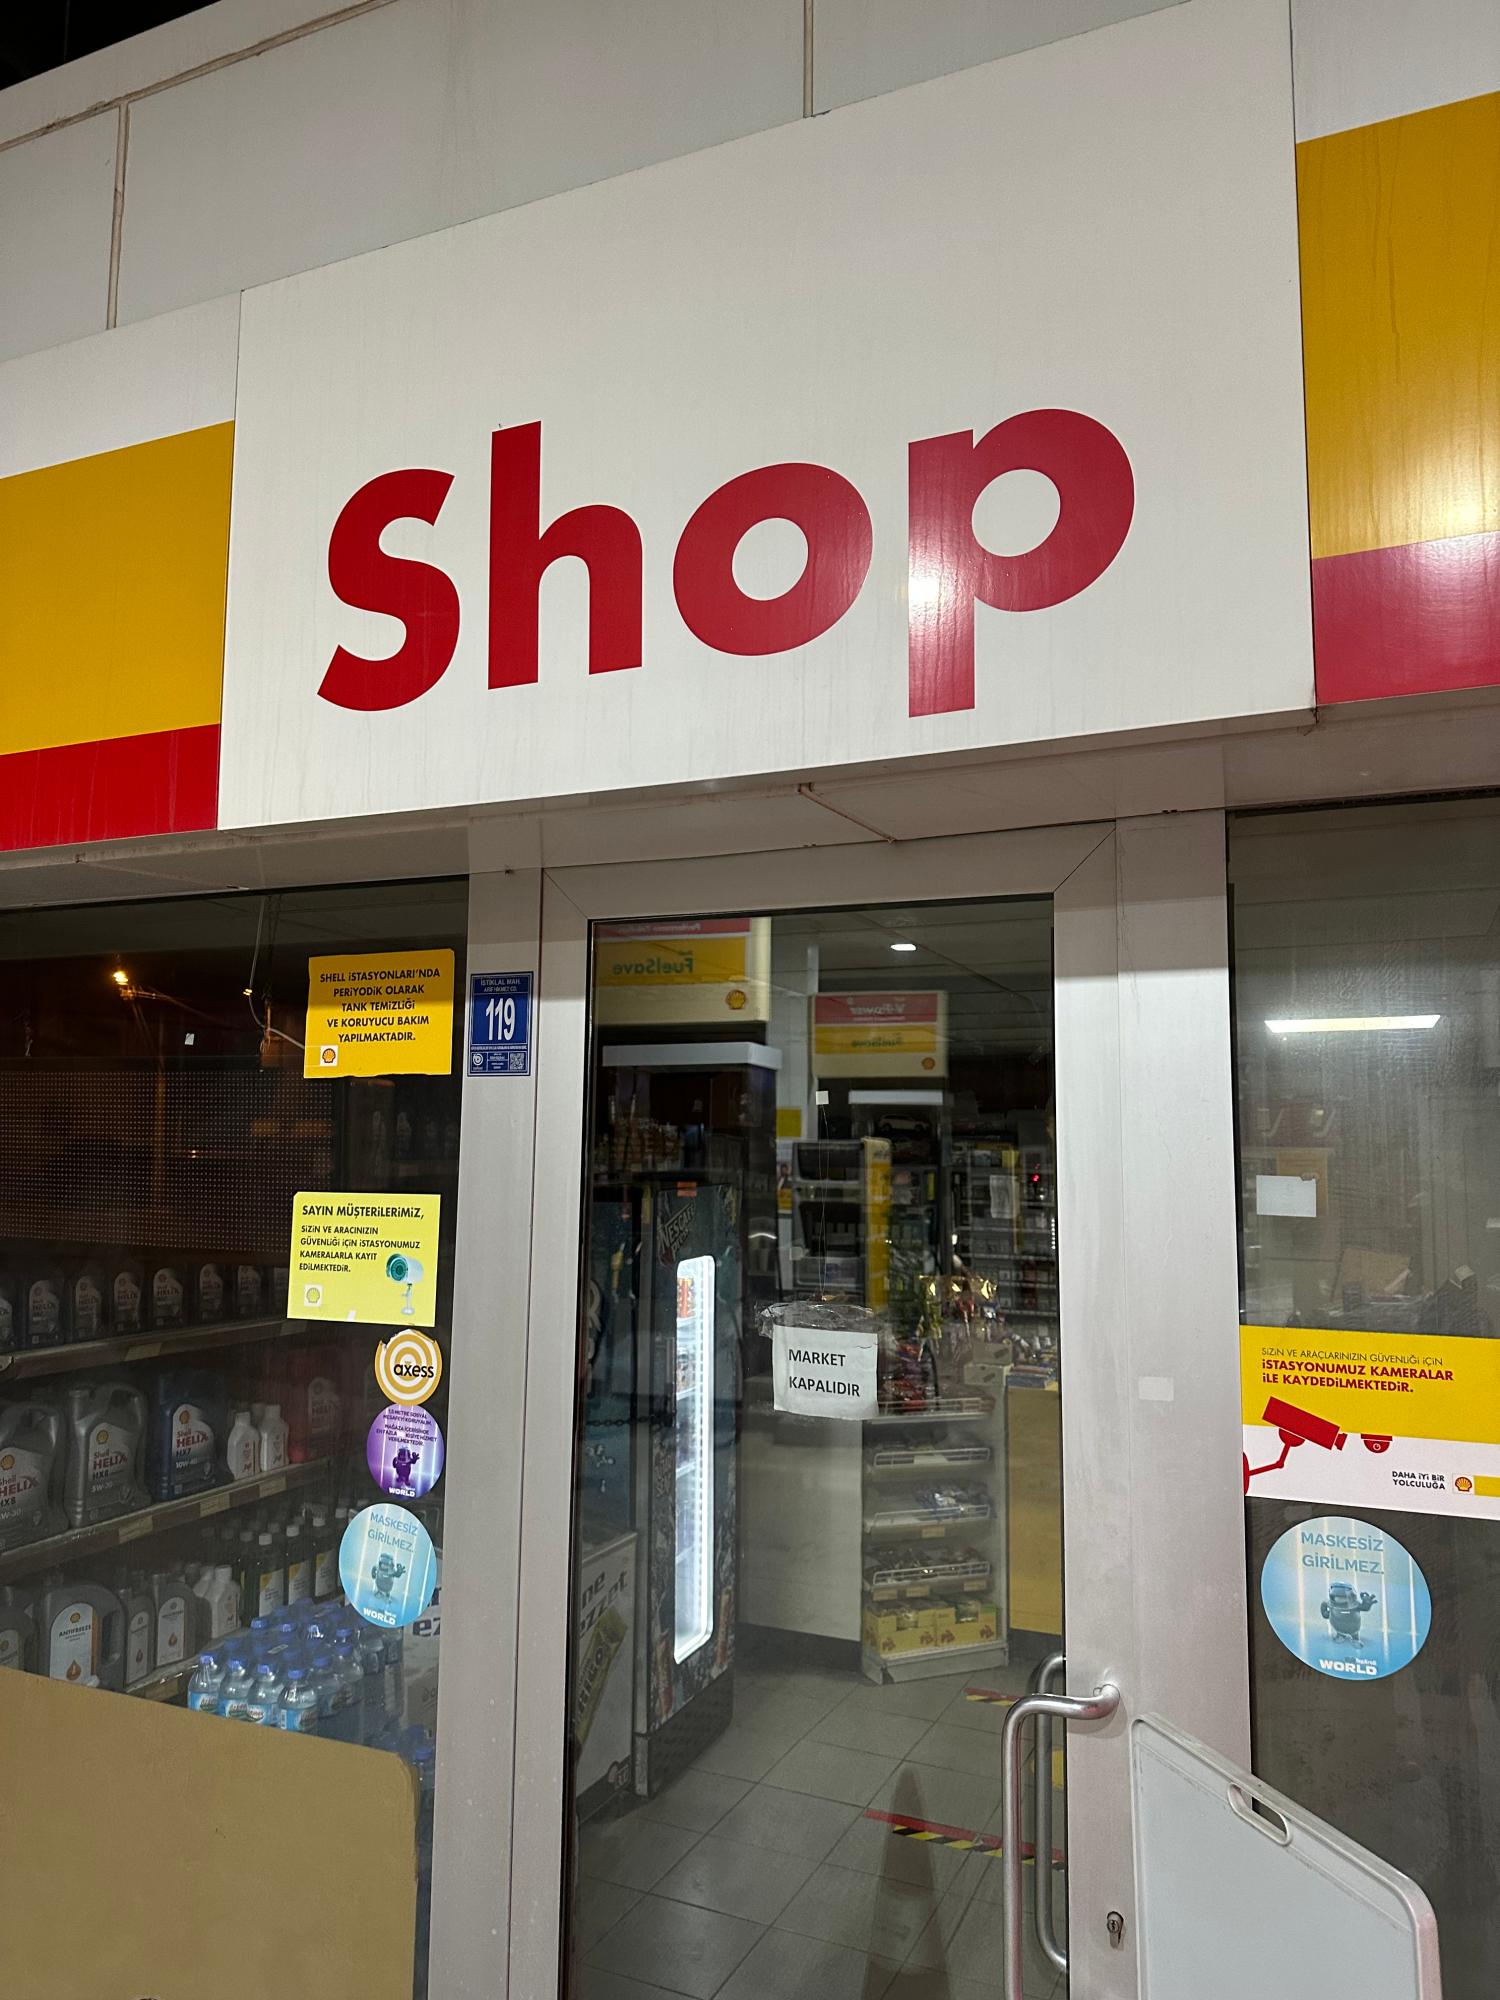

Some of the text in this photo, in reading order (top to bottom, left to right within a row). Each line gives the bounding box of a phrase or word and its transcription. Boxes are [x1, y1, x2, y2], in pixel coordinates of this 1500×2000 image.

[317, 408, 1135, 718] Shop
[320, 973, 346, 983] SHELL
[385, 984, 424, 995] OLARAK
[342, 1002, 367, 1012] TANK
[327, 1015, 430, 1028] VE KORUYUCU BAKIM
[485, 997, 516, 1041] 119
[338, 1031, 416, 1043] YAPILMAKTADIR.
[302, 1204, 334, 1216] SAYIN
[333, 1227, 379, 1235] ARACINIZIN
[299, 1250, 378, 1260] KAMERALARLA KAYIT
[788, 1348, 847, 1367] MARKET
[1288, 1349, 1298, 1358] VE
[1300, 1349, 1368, 1361] ARAÇLARINIZIN
[393, 1363, 435, 1378] axess
[1370, 1365, 1454, 1381] KAMERALAR
[789, 1376, 861, 1398] KAPALIDIR
[176, 1433, 209, 1448] HELIX
[93, 1454, 128, 1470] HELIX
[1392, 1471, 1416, 1480] DAHA
[388, 1487, 416, 1498] WORLD
[363, 1607, 396, 1626] WORLD
[1319, 1659, 1378, 1676] WORLD
